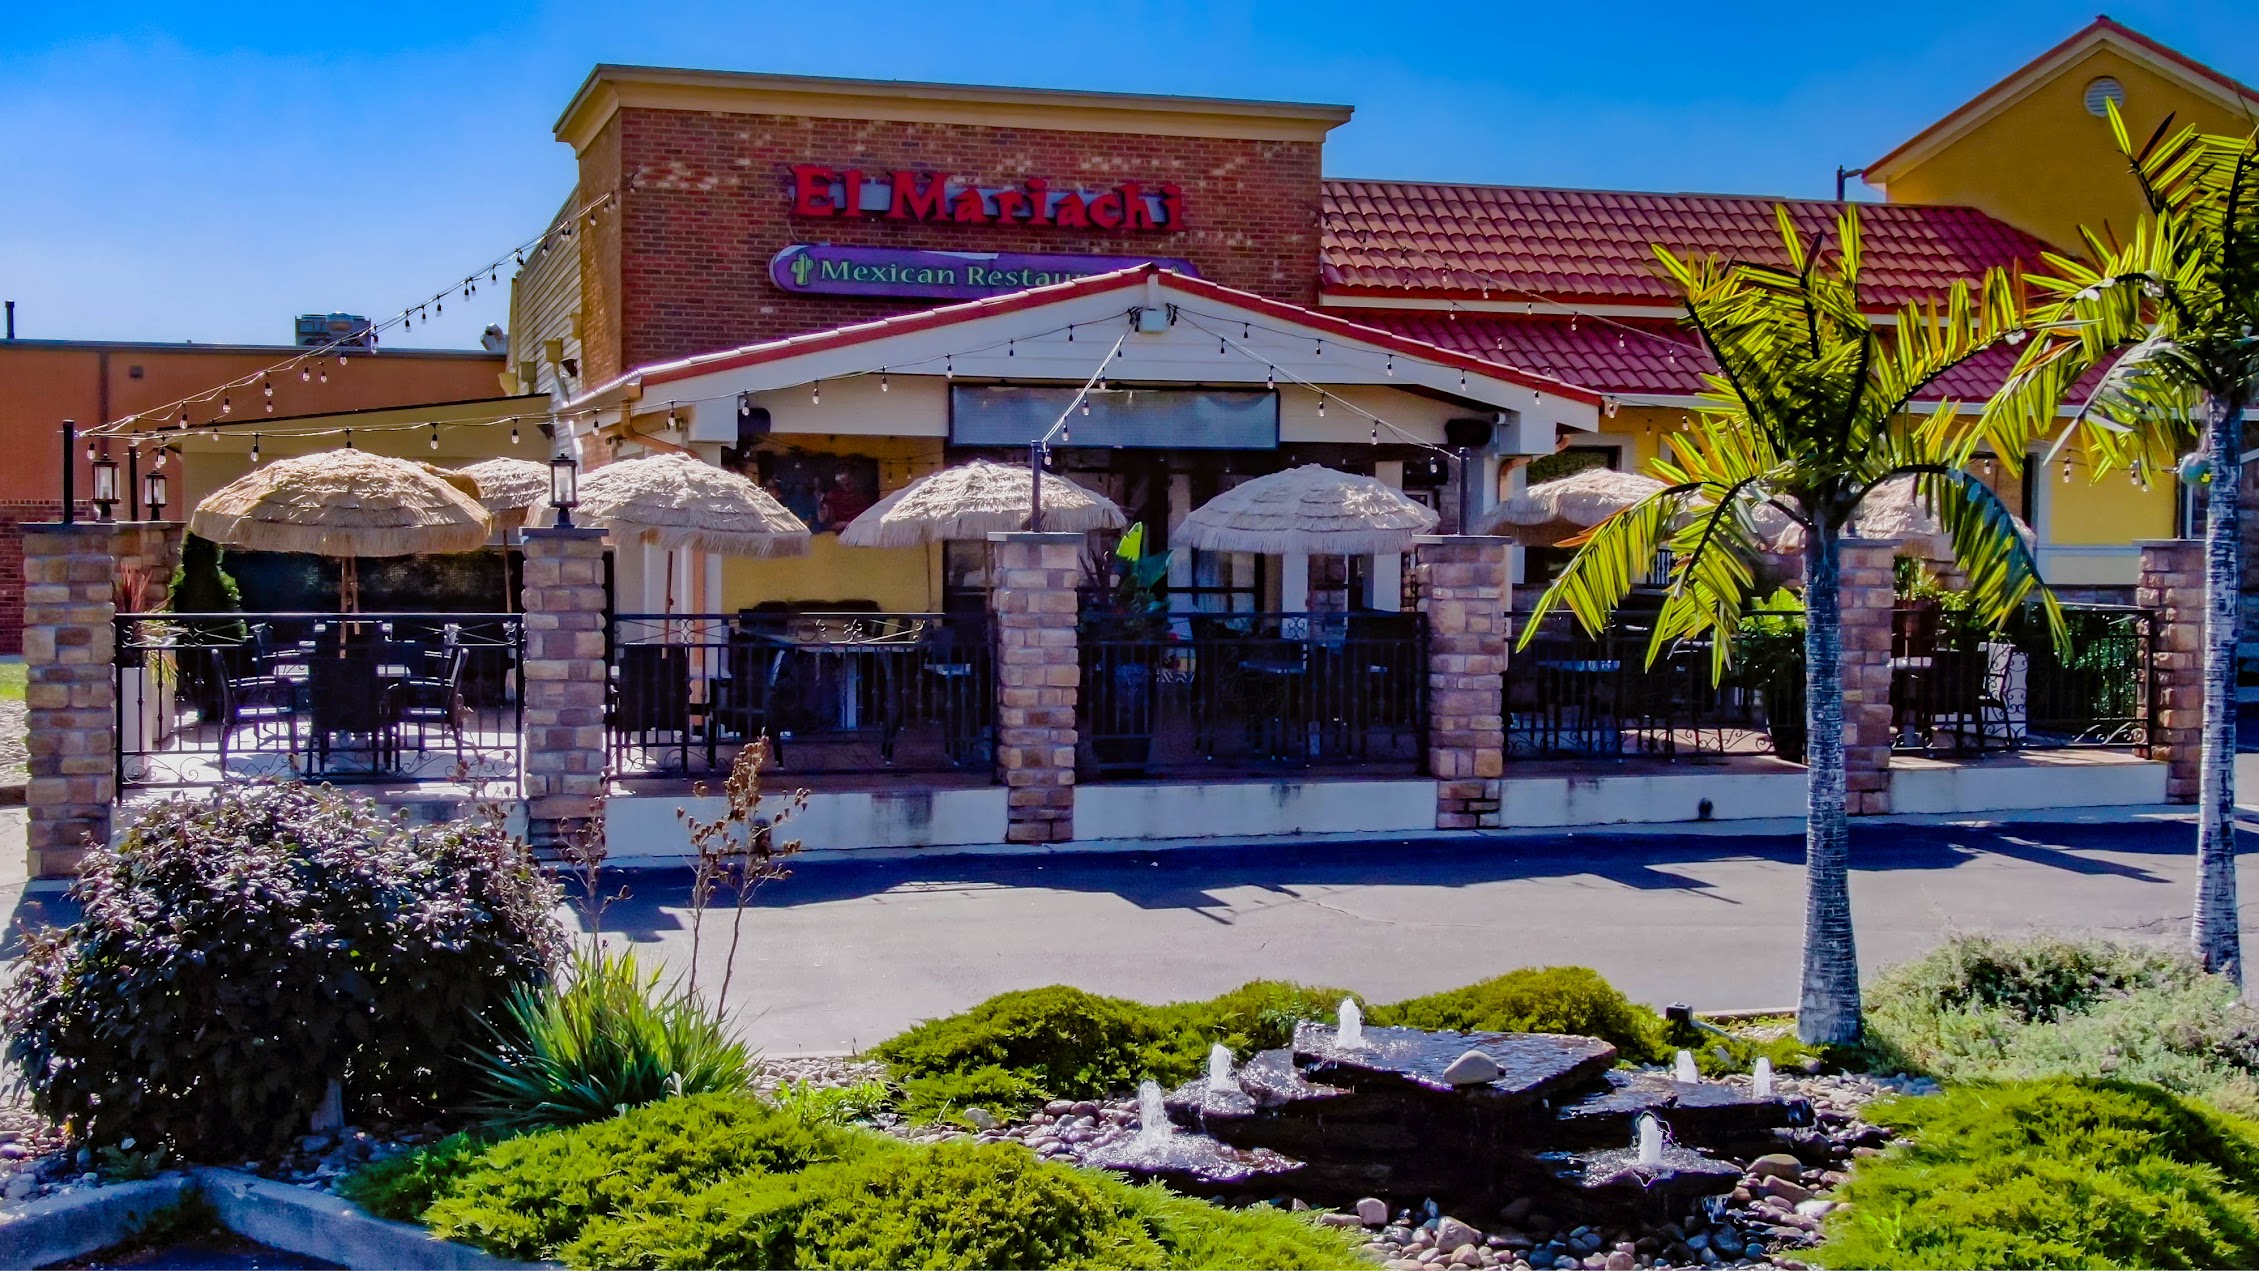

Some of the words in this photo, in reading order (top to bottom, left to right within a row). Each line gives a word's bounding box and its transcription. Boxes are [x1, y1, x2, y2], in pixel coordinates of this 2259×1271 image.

[789, 164, 863, 219] El
[888, 171, 1185, 232] Mariachi
[820, 259, 956, 285] Mexican
